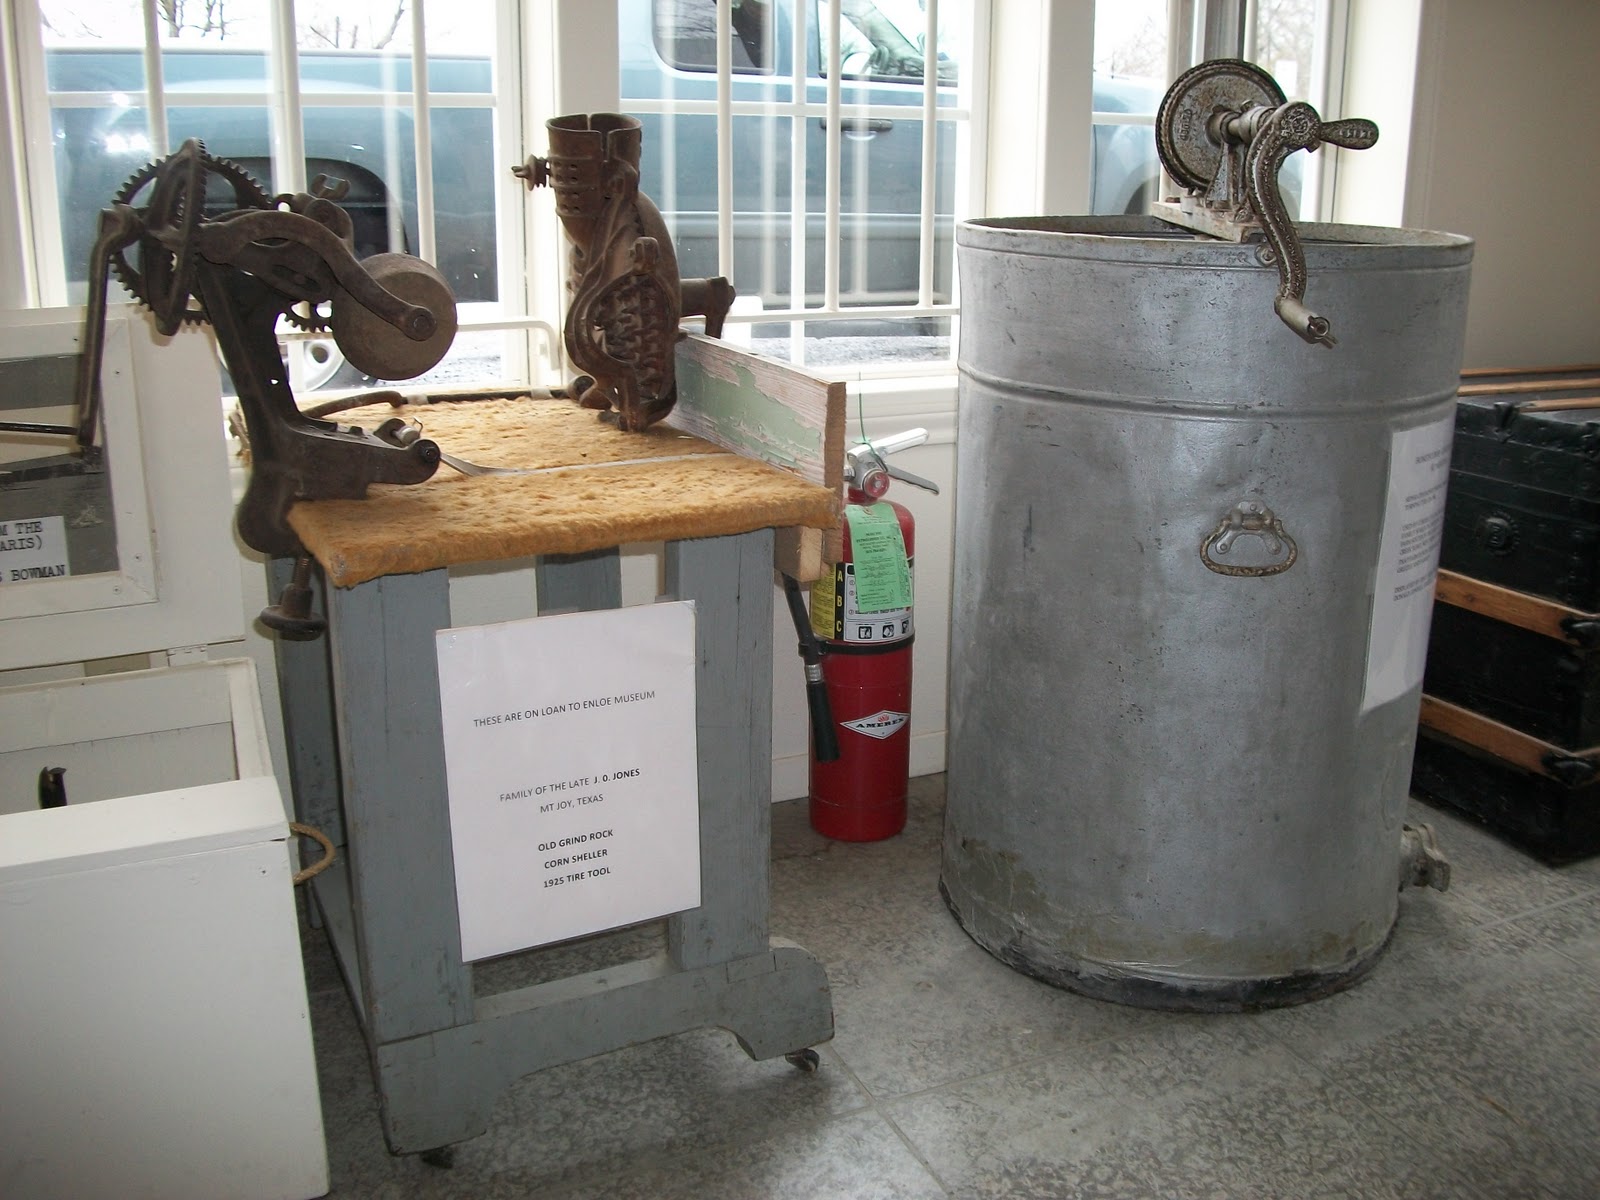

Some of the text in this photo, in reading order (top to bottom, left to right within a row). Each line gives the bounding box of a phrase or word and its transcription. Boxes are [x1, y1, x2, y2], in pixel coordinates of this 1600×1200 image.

[15, 521, 42, 534] THE
[11, 564, 65, 581] BOWMAN
[837, 573, 843, 582] A
[837, 596, 842, 607] B
[836, 622, 842, 632] C
[473, 690, 656, 728] THESE ARE ON LOAN TO ENLOE MUSEUM
[856, 717, 904, 728] AMEREX
[500, 788, 533, 802] FAMILY
[535, 785, 547, 795] OF
[549, 781, 566, 792] THE
[568, 777, 589, 789] LATE
[612, 768, 640, 781] JONES
[540, 793, 604, 813] MT JOY, TEXAS
[538, 829, 614, 852] OLD GRIND ROCK
[544, 848, 608, 869] CORN SHELLER
[543, 866, 611, 889] 1925 TIRE TOOL
